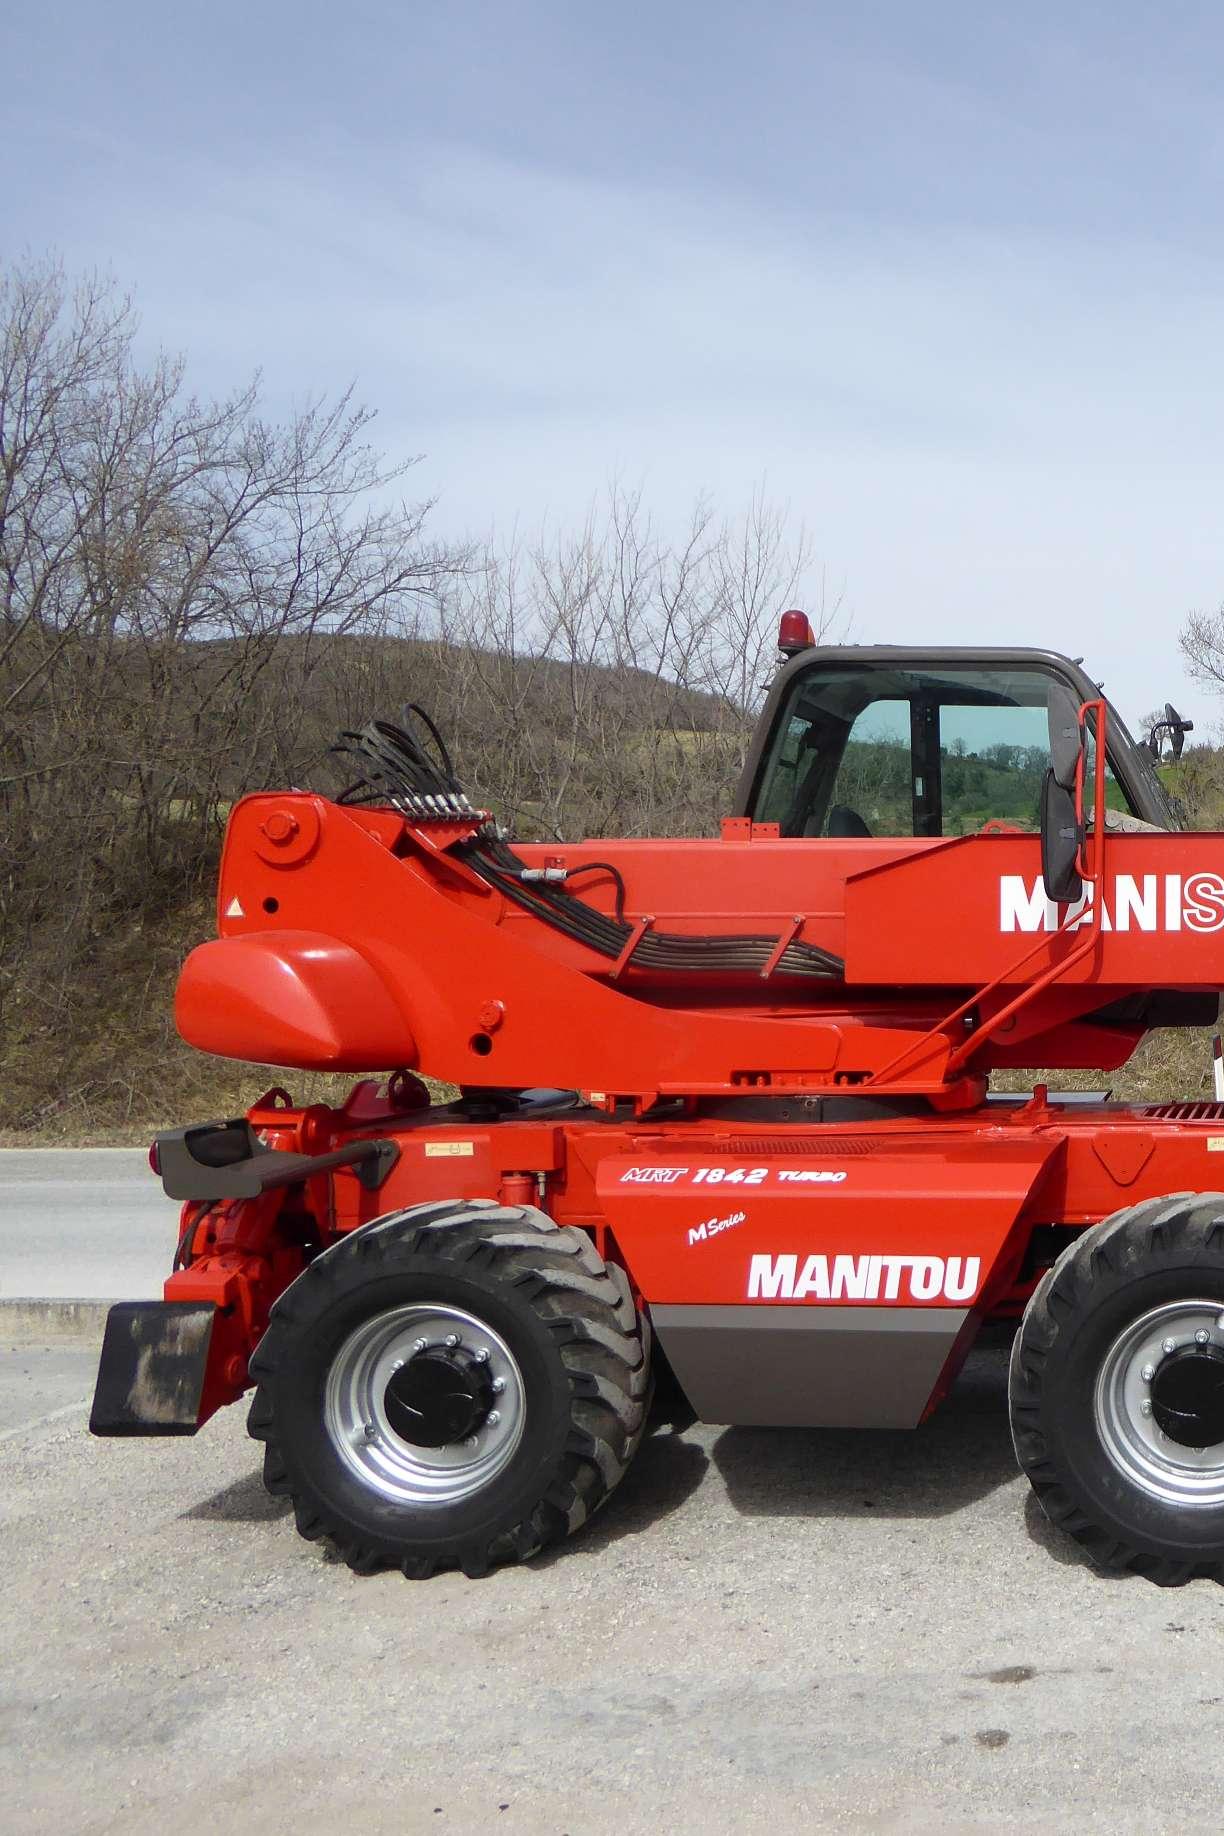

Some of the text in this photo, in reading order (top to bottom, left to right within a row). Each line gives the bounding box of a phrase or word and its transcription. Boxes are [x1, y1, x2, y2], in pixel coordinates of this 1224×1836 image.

[620, 1168, 848, 1184] MRT 1842 TURBO
[747, 1254, 981, 1300] MANITOU
